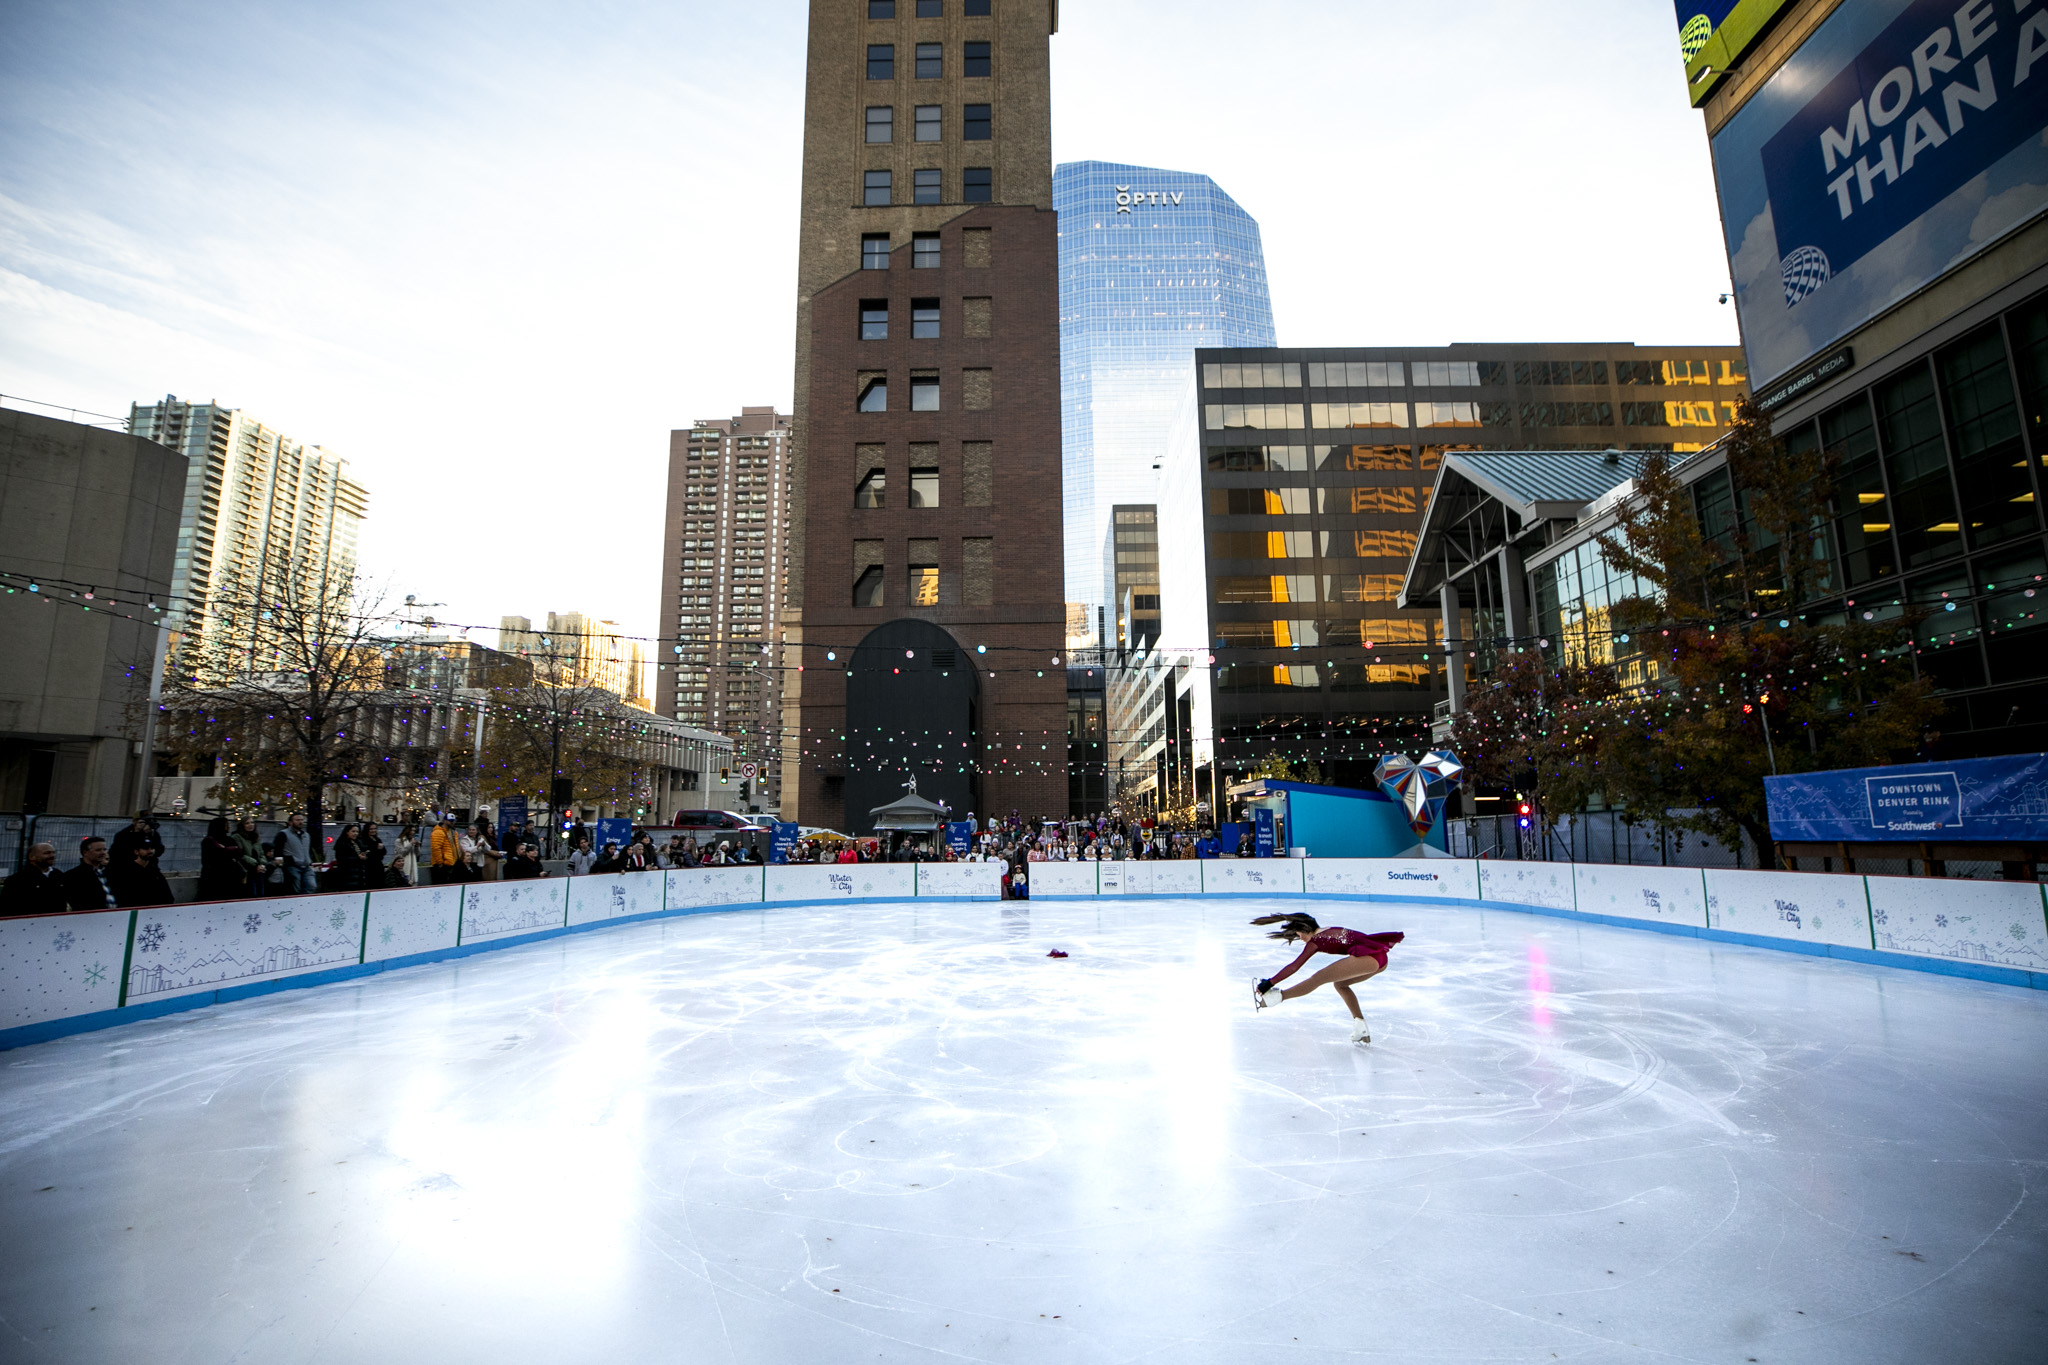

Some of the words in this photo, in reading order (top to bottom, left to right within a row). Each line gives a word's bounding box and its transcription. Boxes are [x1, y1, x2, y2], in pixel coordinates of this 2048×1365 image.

[1820, 0, 1998, 175] MORE
[1827, 54, 1998, 221] THAN
[1116, 189, 1183, 208] OPTIV
[1758, 389, 1787, 411] RANGE
[1787, 373, 1816, 395] BARREL
[1818, 355, 1845, 376] MEDIA
[1882, 784, 1942, 795] DOWNTOWN
[1878, 798, 1918, 808] DENVER
[1923, 796, 1950, 806] RINK
[1888, 821, 1936, 831] Southwest
[828, 874, 852, 882] Winter
[1387, 871, 1433, 881] Southwest
[839, 882, 852, 894] City
[1774, 899, 1800, 912] Winter
[1787, 911, 1801, 929] City
